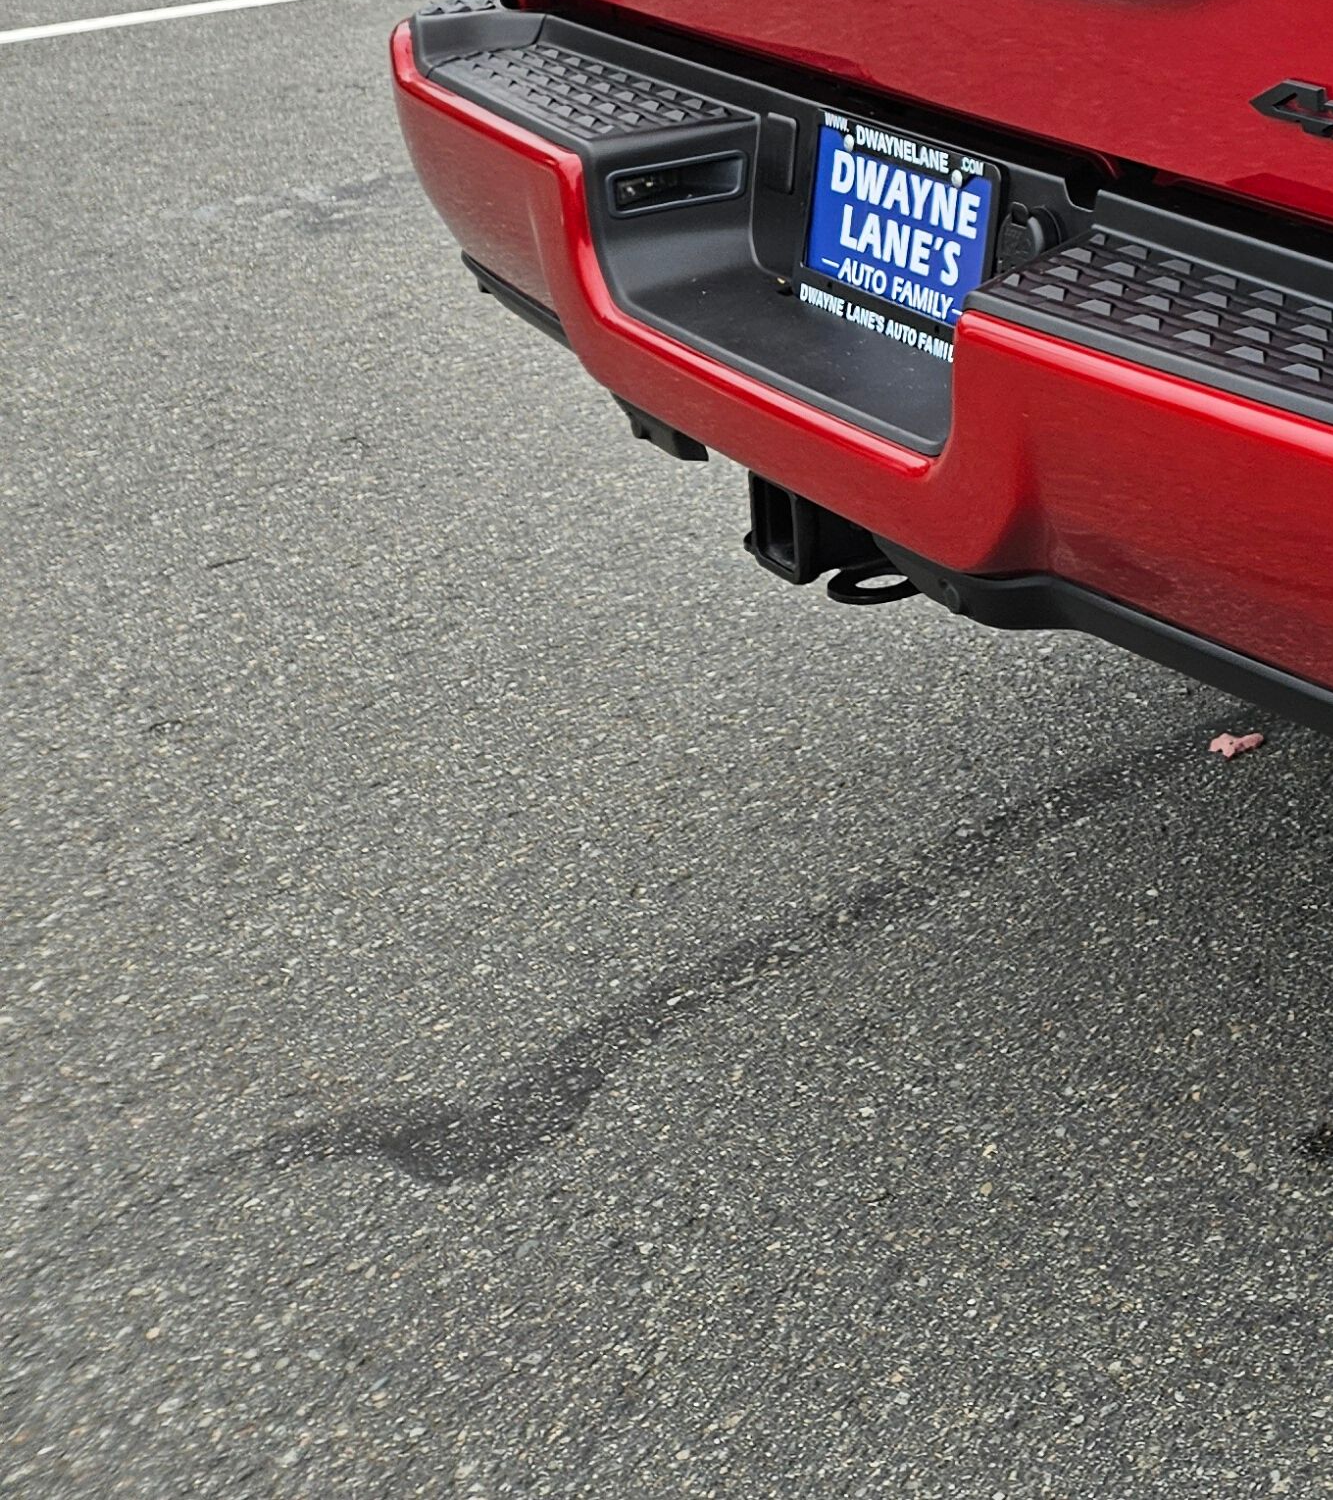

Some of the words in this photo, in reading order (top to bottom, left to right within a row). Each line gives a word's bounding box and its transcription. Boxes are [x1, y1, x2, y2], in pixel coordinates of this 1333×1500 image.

[856, 124, 950, 174] DWAYNELANE
[960, 156, 985, 176] .COM
[830, 149, 982, 240] DWAYNE
[839, 203, 962, 287] LANE'S
[800, 282, 846, 318] DWAYNE
[845, 302, 885, 334] LANE'S
[884, 319, 918, 347] AUTO
[917, 331, 955, 363] FAMIL
[837, 257, 888, 296] AUTO
[891, 275, 954, 321] FAMILY
